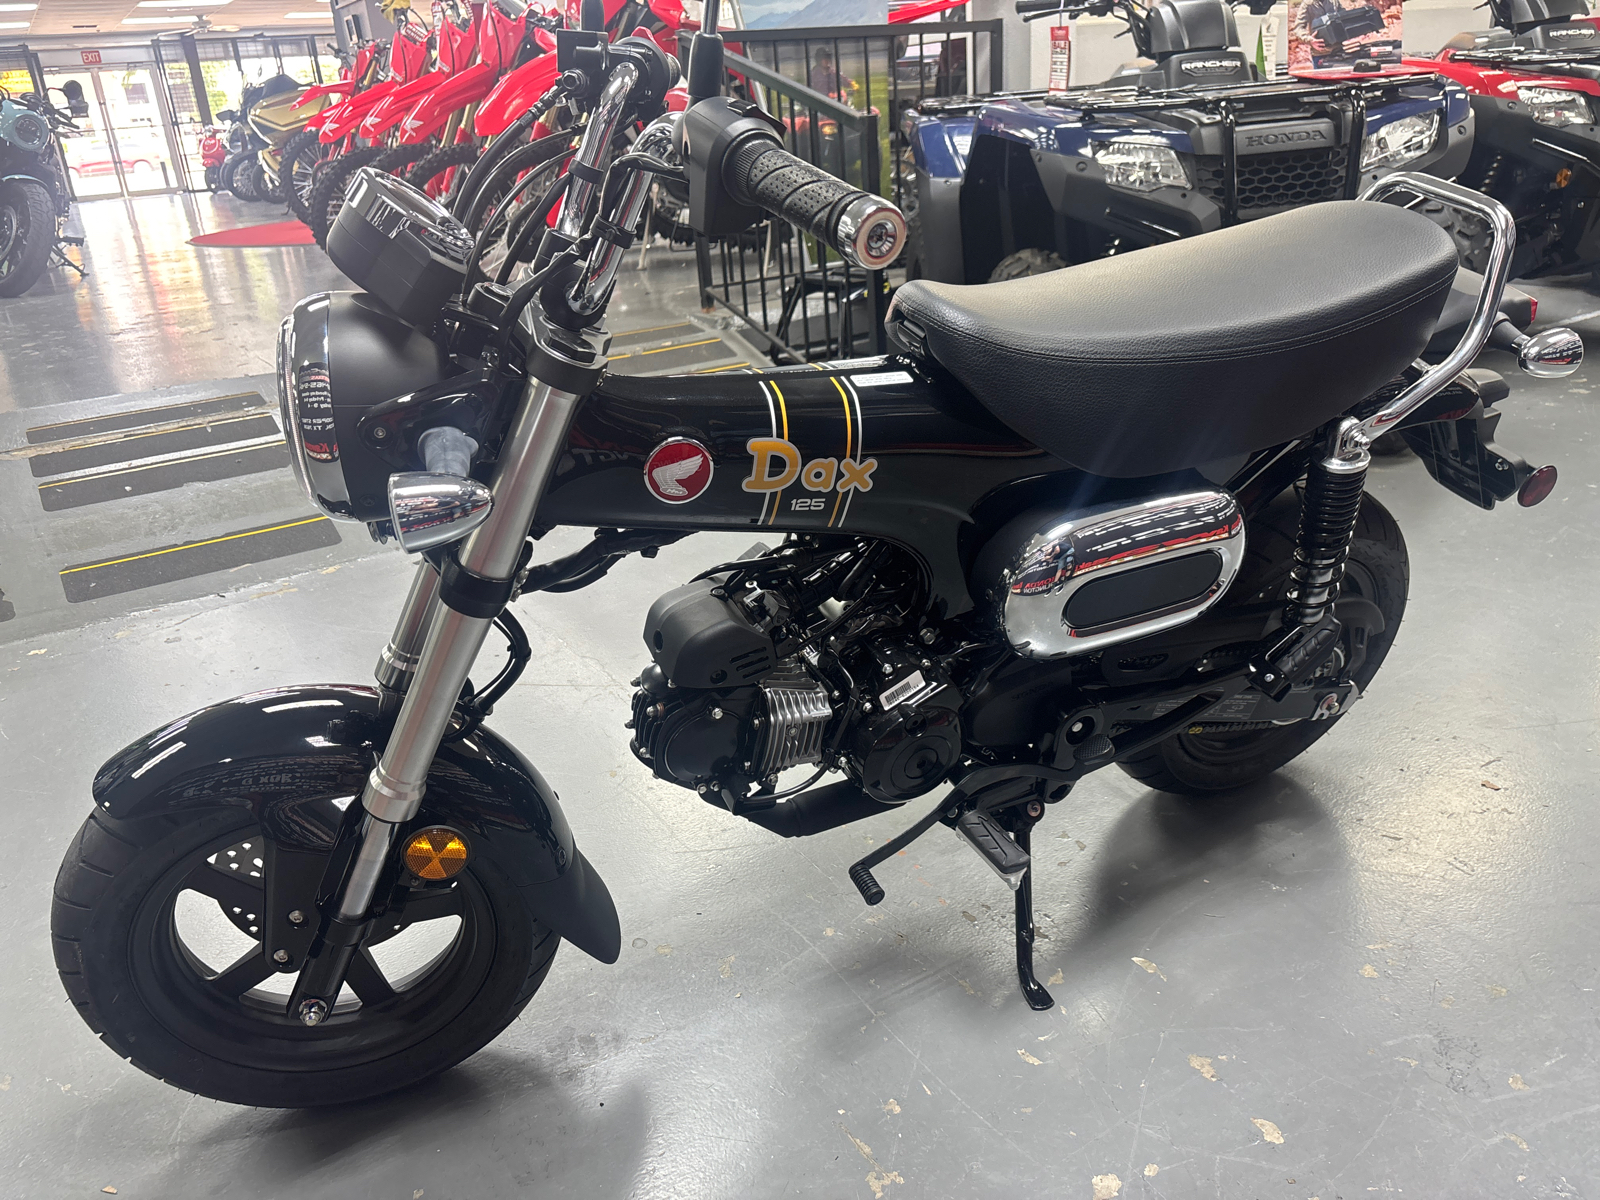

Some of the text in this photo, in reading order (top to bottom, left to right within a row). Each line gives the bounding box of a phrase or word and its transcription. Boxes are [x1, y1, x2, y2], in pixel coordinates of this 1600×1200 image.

[1549, 29, 1595, 37] RANCHER
[82, 52, 100, 63] EXIT
[1181, 60, 1241, 70] RANCHER
[1244, 129, 1327, 147] HONDA
[741, 437, 879, 493] Dax
[790, 498, 826, 511] 125
